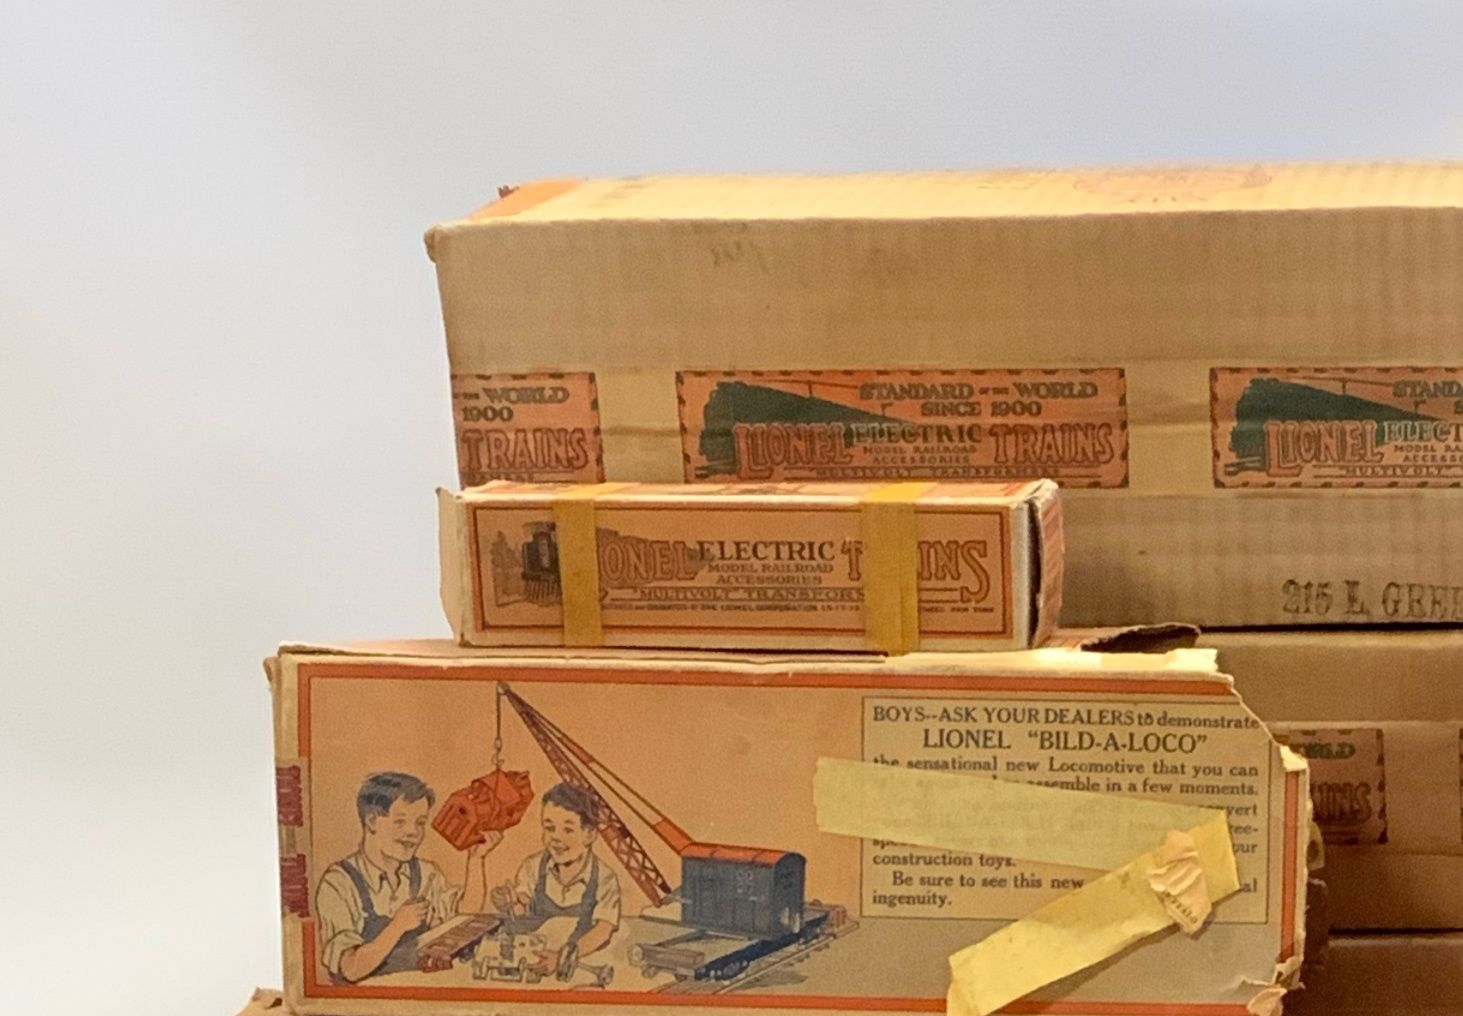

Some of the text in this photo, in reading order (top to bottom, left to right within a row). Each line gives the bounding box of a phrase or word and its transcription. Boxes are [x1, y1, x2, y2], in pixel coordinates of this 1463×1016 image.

[483, 386, 569, 404] WORLD
[860, 382, 973, 400] STANDARD
[1013, 382, 1098, 398] WORLD
[463, 405, 514, 422] 1900
[921, 401, 1041, 416] SINCE 1900
[463, 428, 589, 470] TRAINS
[734, 422, 1114, 480] LIONEL ELECTRIC TRAINS
[1264, 420, 1384, 477] LIONEL
[697, 540, 835, 562] ELECTRIC
[708, 563, 833, 574] MODEL RAILROAD
[715, 574, 823, 585] ACCESSORIES
[1281, 579, 1371, 615] 215 L
[984, 707, 1260, 729] YOUR DEALERS demonstrate
[923, 728, 1011, 749] LIONEL
[907, 755, 1259, 779] sensational new Locomotive that you can
[1106, 777, 1259, 796] in few moments.
[873, 852, 1017, 870] construction toys.
[892, 871, 1085, 889] Be sure to see this new
[873, 890, 953, 908] ingenuity.
